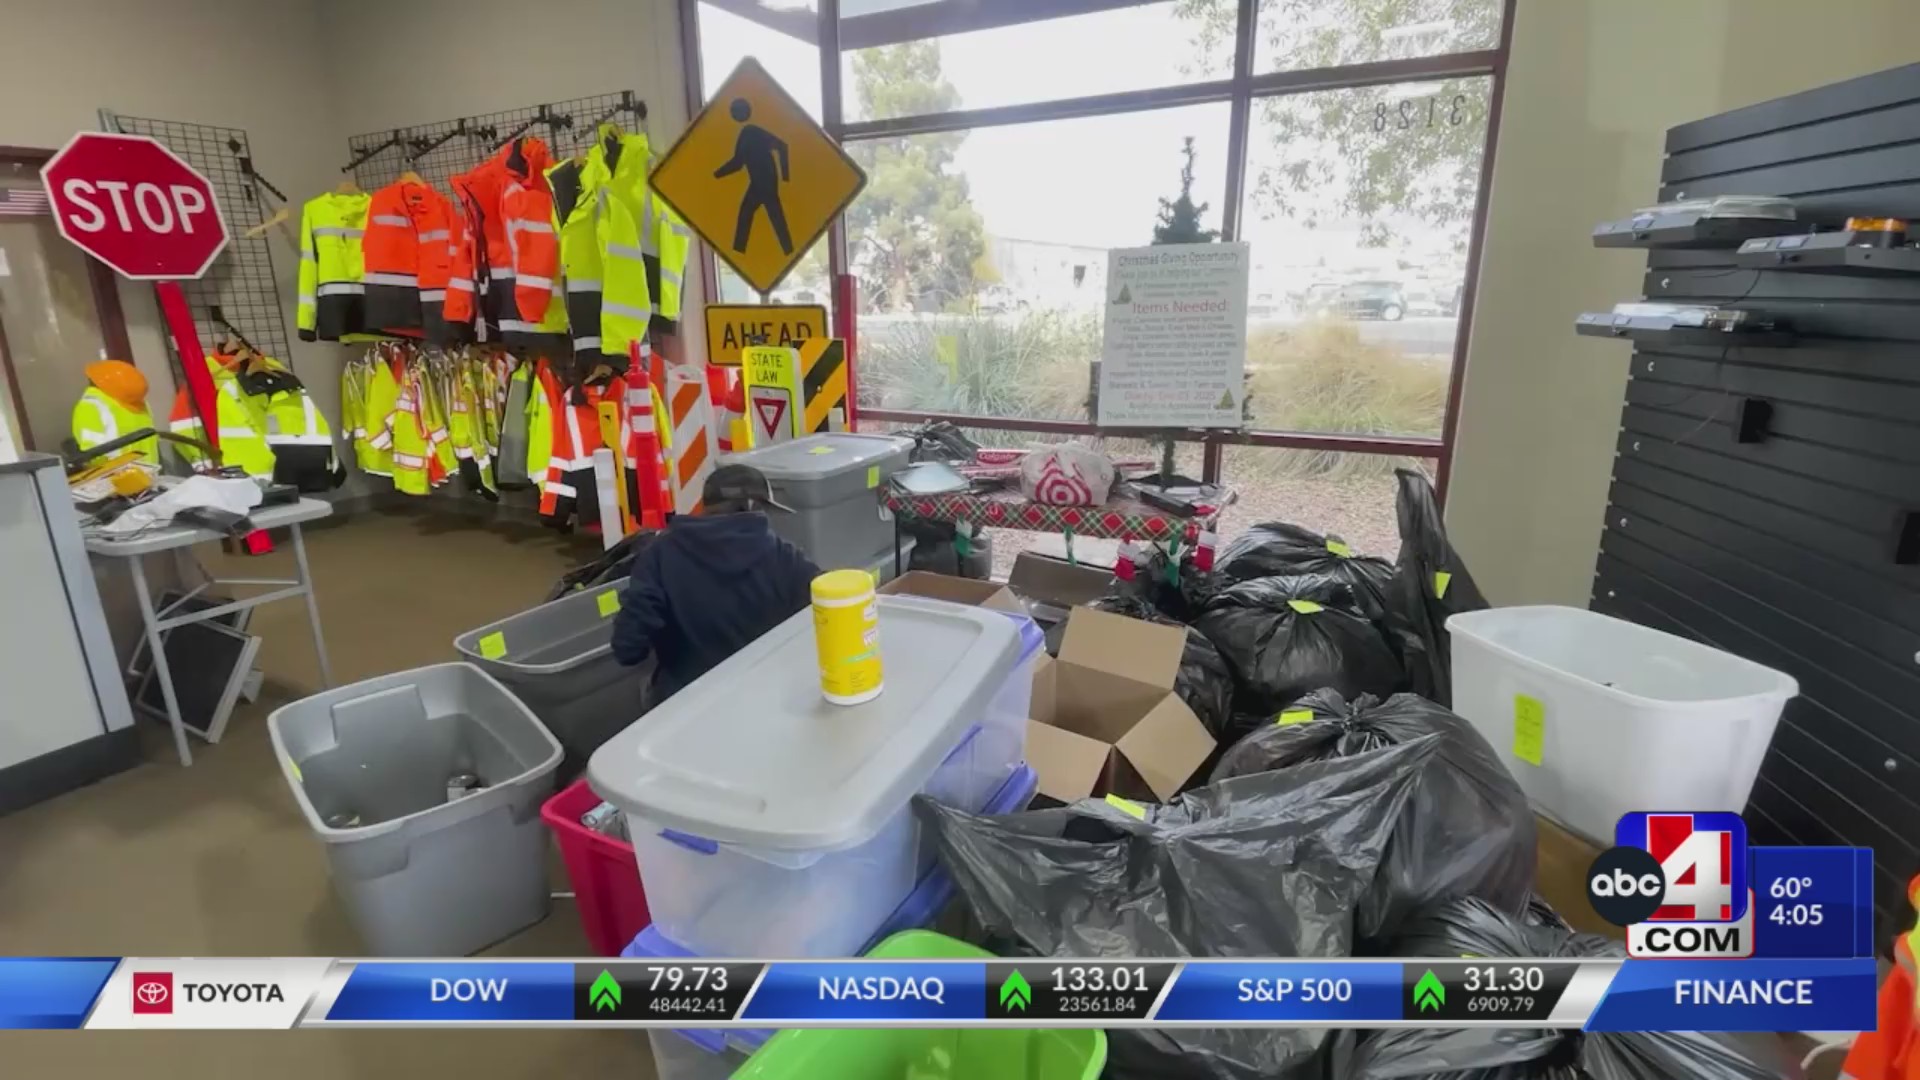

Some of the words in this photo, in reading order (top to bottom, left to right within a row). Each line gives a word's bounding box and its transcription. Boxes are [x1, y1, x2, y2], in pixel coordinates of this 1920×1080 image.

[63, 178, 206, 234] STOP
[1133, 302, 1169, 314] Items
[1173, 299, 1231, 313] Needed:
[723, 321, 812, 349] AHEAD
[750, 353, 783, 368] STATE
[755, 370, 779, 384] LAW
[979, 452, 1017, 464] Colgate
